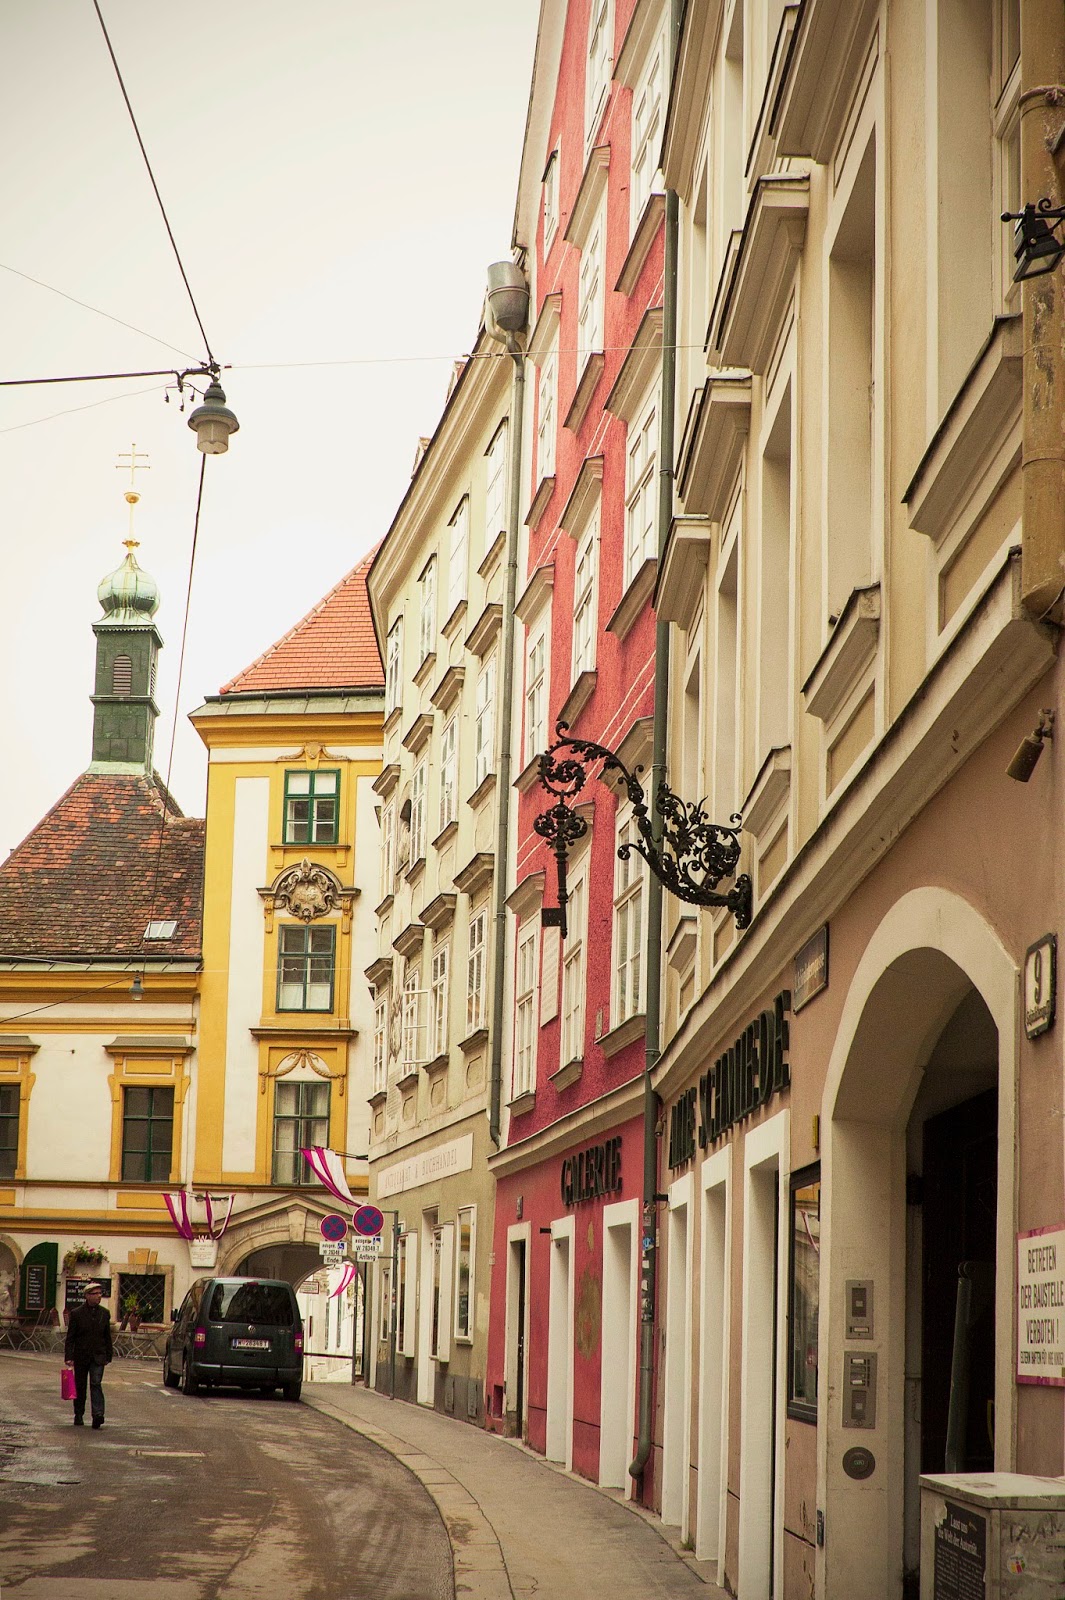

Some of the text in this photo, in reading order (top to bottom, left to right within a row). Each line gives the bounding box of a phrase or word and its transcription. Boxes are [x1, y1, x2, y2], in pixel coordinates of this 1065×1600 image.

[1034, 949, 1042, 1005] 9
[698, 989, 791, 1149] SCHMIEDE
[561, 1135, 622, 1207] GALERIE
[1028, 1244, 1057, 1274] BETRETEN
[1020, 1281, 1064, 1309] DER BAUSTELLE
[1026, 1318, 1055, 1344] VERBOTEN
